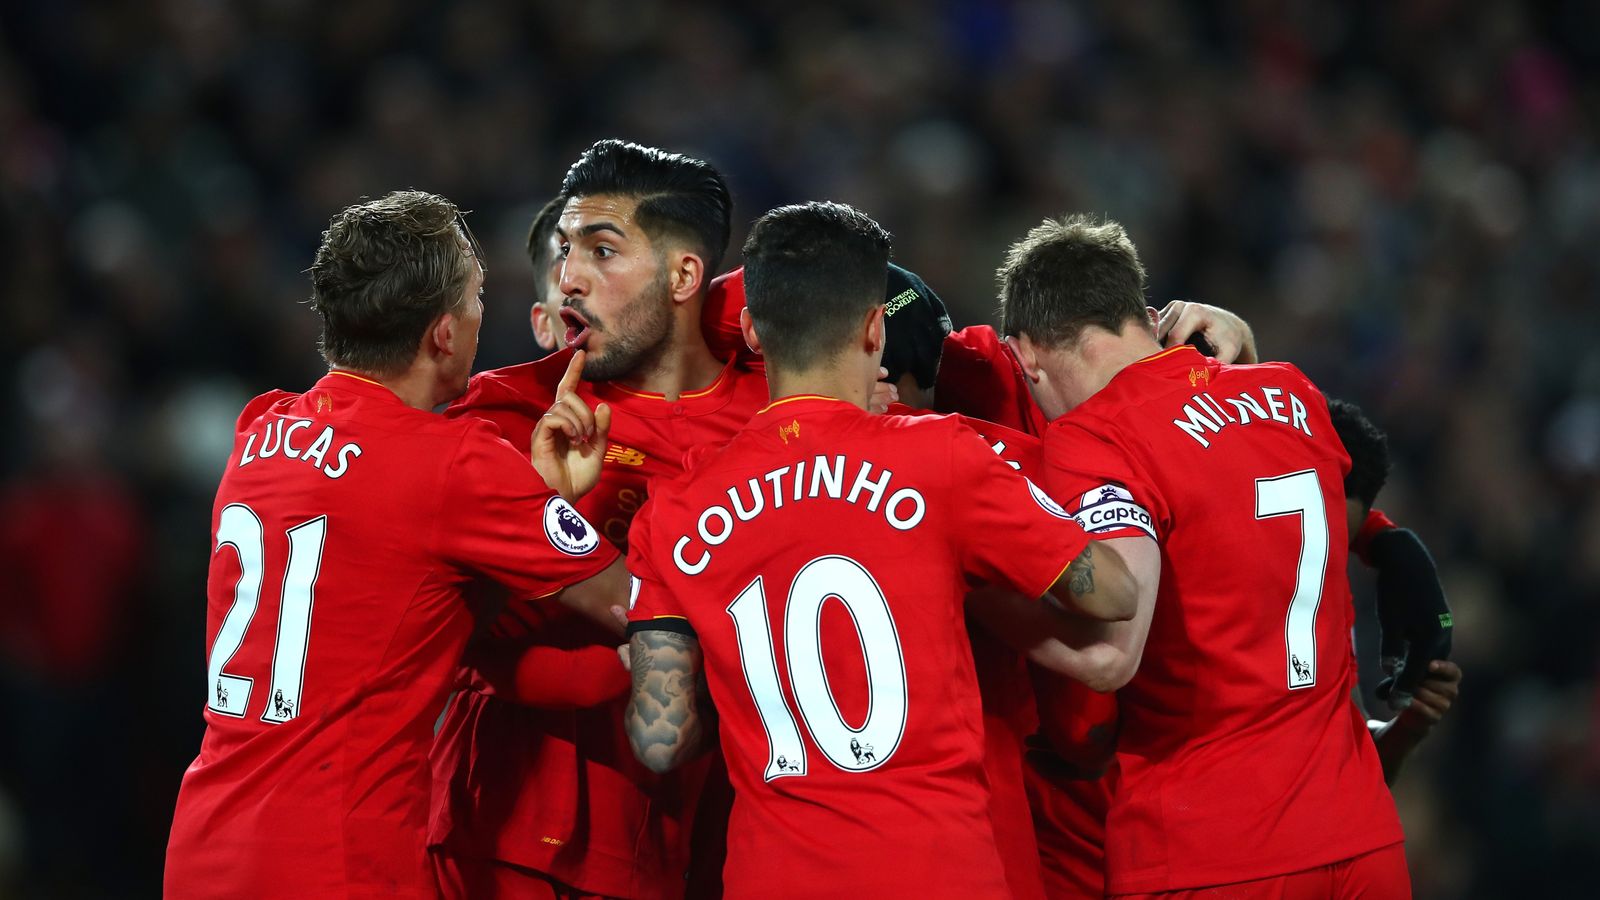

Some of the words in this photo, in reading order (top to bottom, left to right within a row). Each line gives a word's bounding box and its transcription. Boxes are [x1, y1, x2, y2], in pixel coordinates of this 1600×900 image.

[239, 418, 362, 479] LUCAS
[1173, 386, 1313, 448] MILNER
[553, 531, 570, 548] Premier
[570, 543, 589, 551] League
[672, 454, 926, 576] COUTINHO
[1089, 505, 1156, 532] Captai
[208, 503, 327, 724] 21
[1255, 468, 1329, 690] 7
[725, 554, 908, 783] 10
